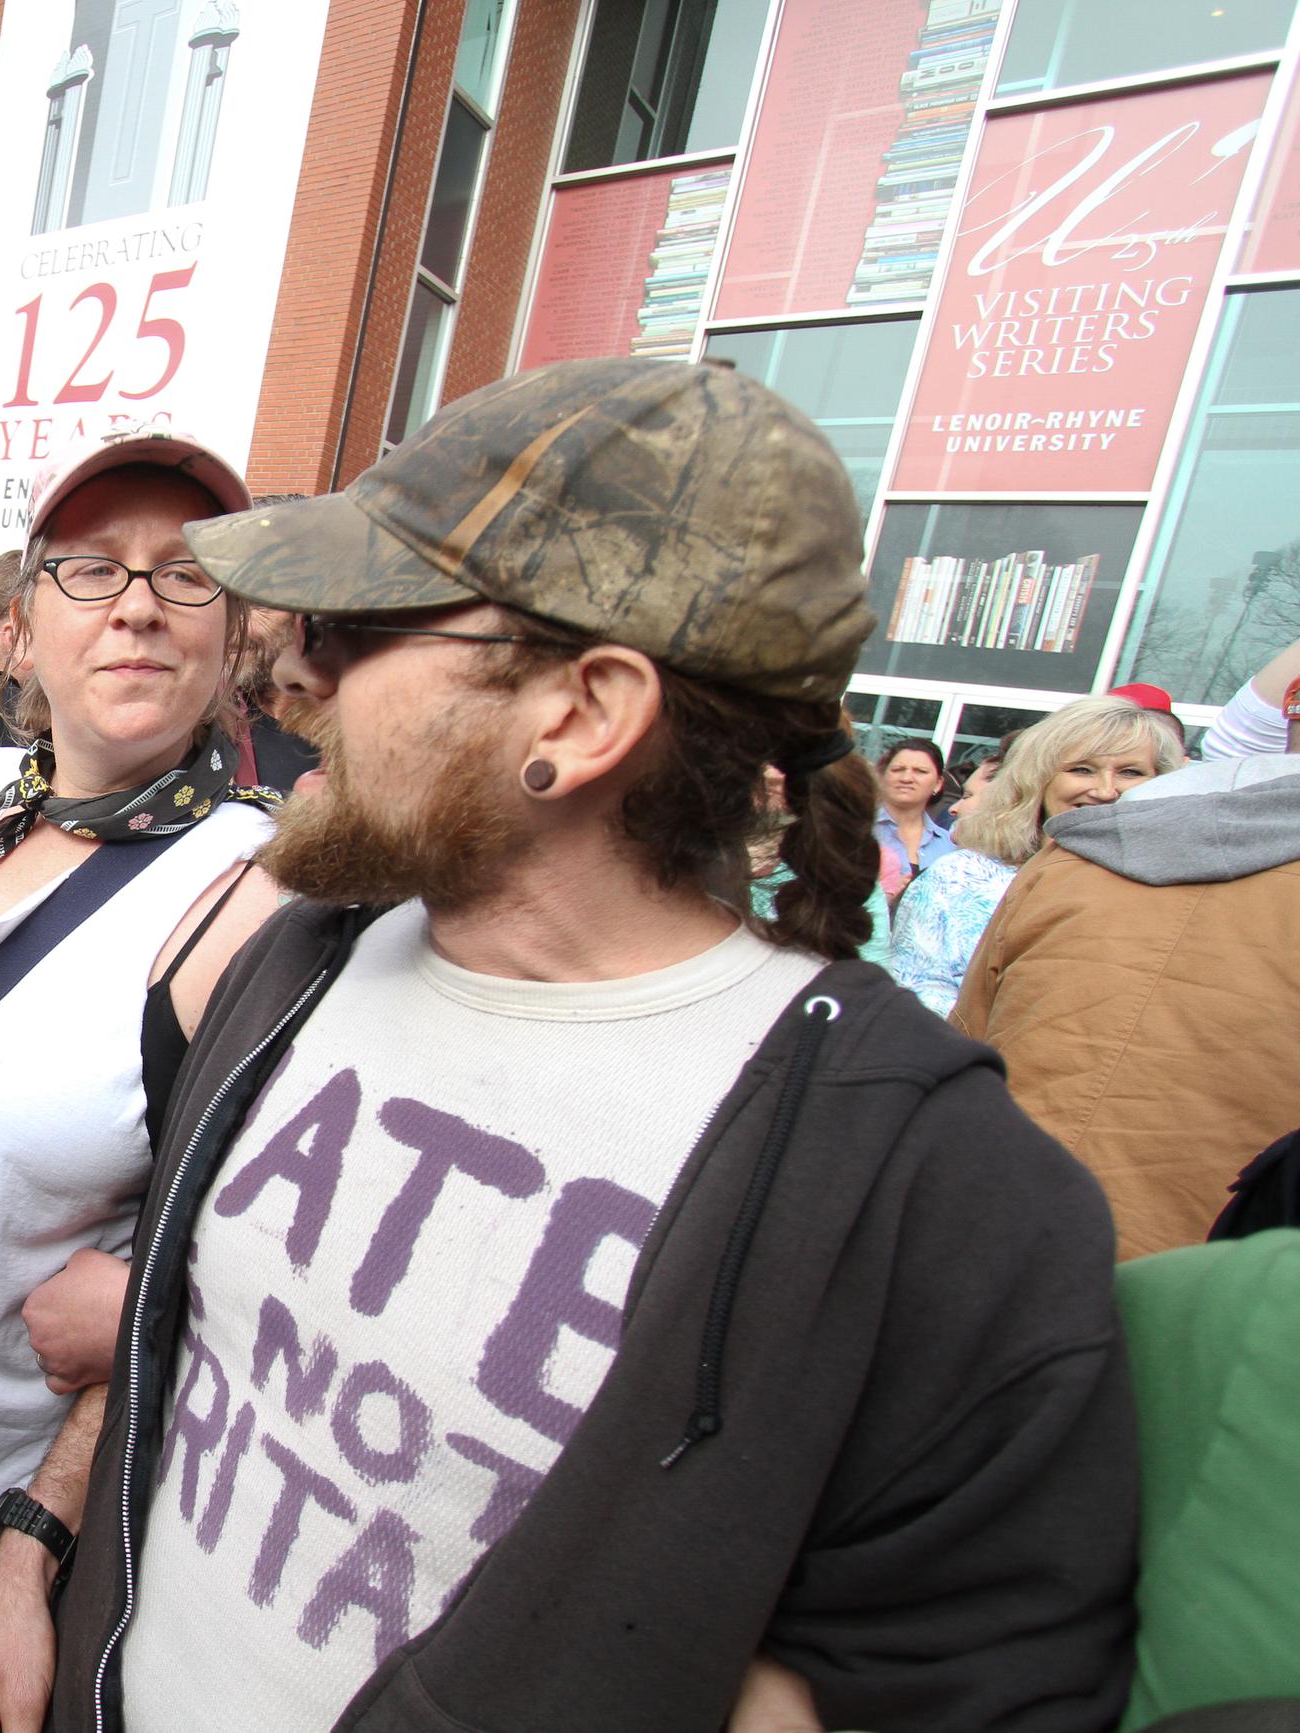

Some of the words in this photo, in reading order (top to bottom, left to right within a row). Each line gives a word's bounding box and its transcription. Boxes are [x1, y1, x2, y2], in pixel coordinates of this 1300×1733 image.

[20, 222, 204, 280] CELEBRATING
[972, 275, 1194, 321] VISITING
[1, 259, 199, 409] 125
[951, 309, 1160, 352] WRITERS
[966, 343, 1119, 380] SERIES
[0, 411, 173, 461] YEA
[945, 432, 1117, 453] UNIVERSITY
[213, 1045, 662, 1452] ATE
